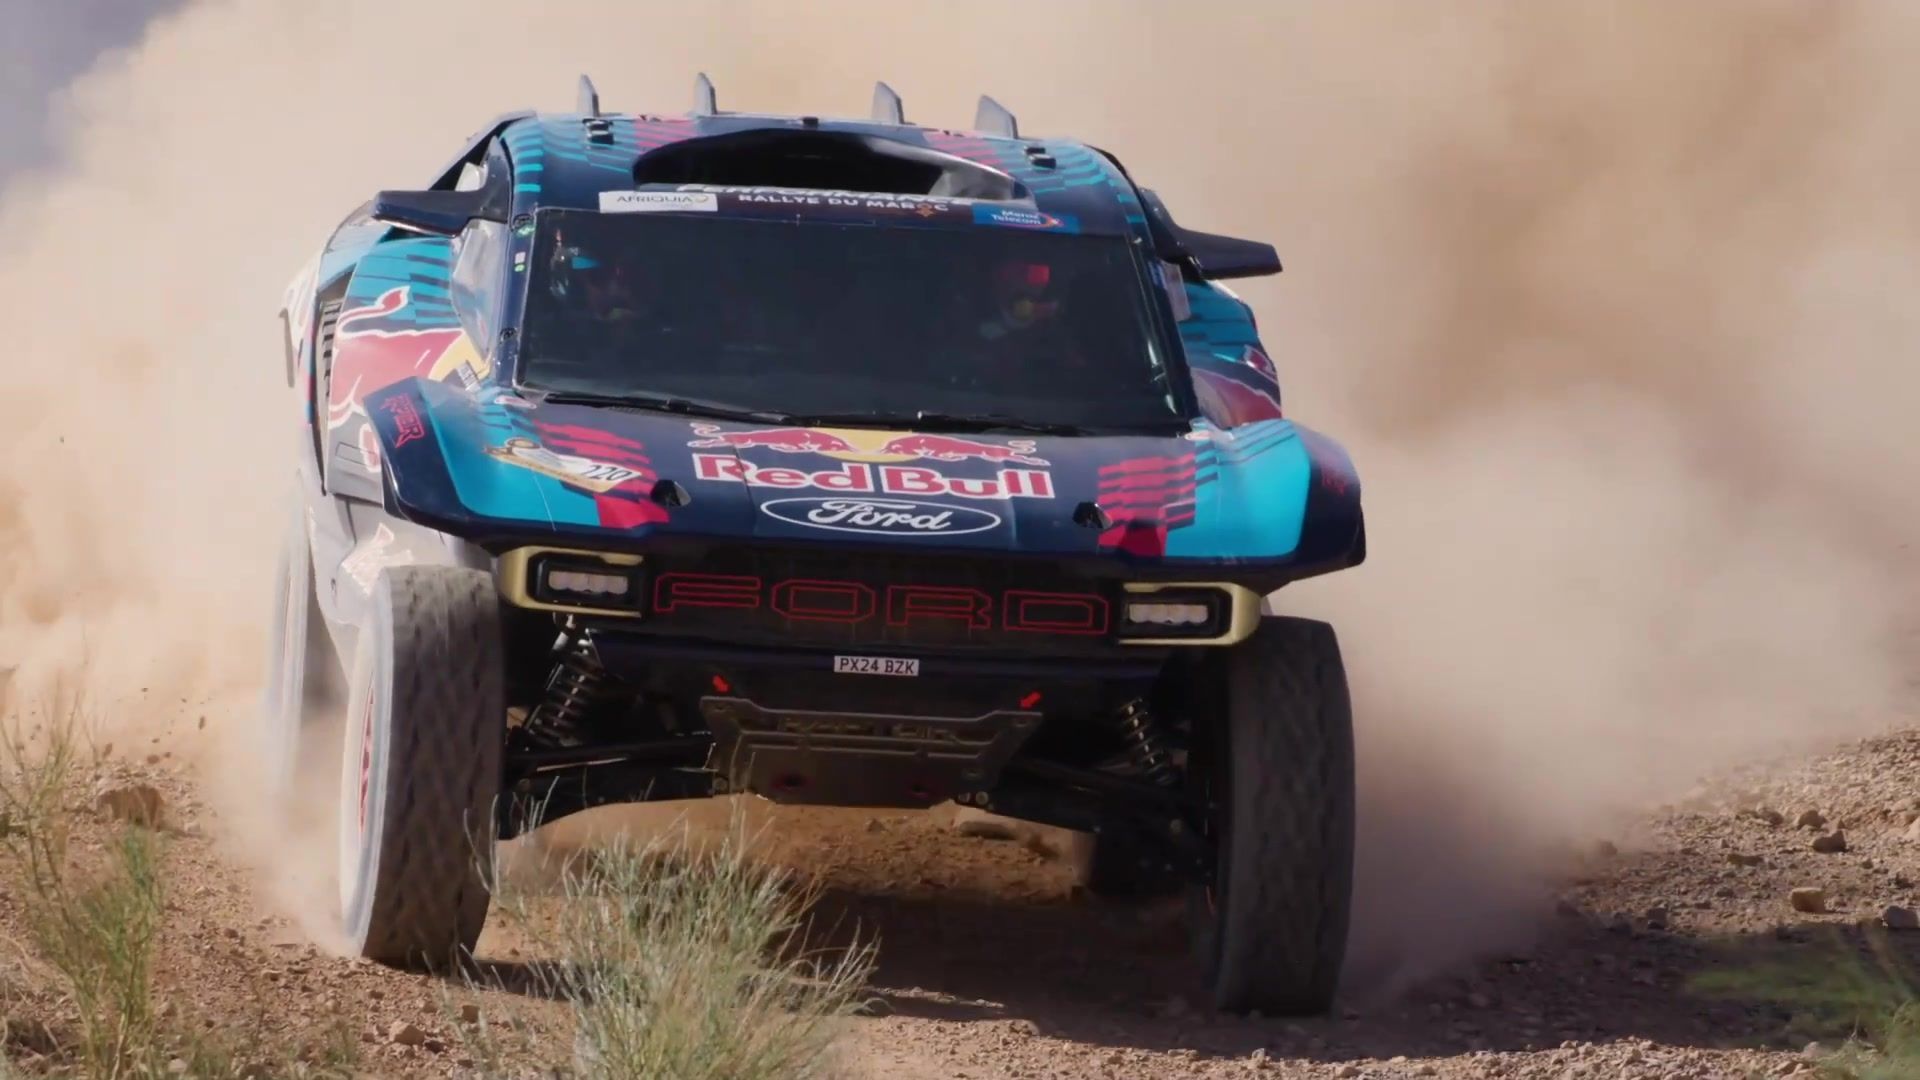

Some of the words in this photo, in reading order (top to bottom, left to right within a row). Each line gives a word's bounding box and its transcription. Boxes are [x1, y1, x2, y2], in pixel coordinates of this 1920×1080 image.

[616, 195, 693, 204] AFRIQUIA
[738, 194, 820, 205] RALLYE
[828, 198, 859, 206] DU
[692, 453, 875, 493] Red
[878, 465, 1055, 500] Bull
[807, 500, 953, 532] Ford
[654, 572, 1110, 635] FORD
[839, 658, 880, 673] PX24
[884, 659, 915, 674] BZK
